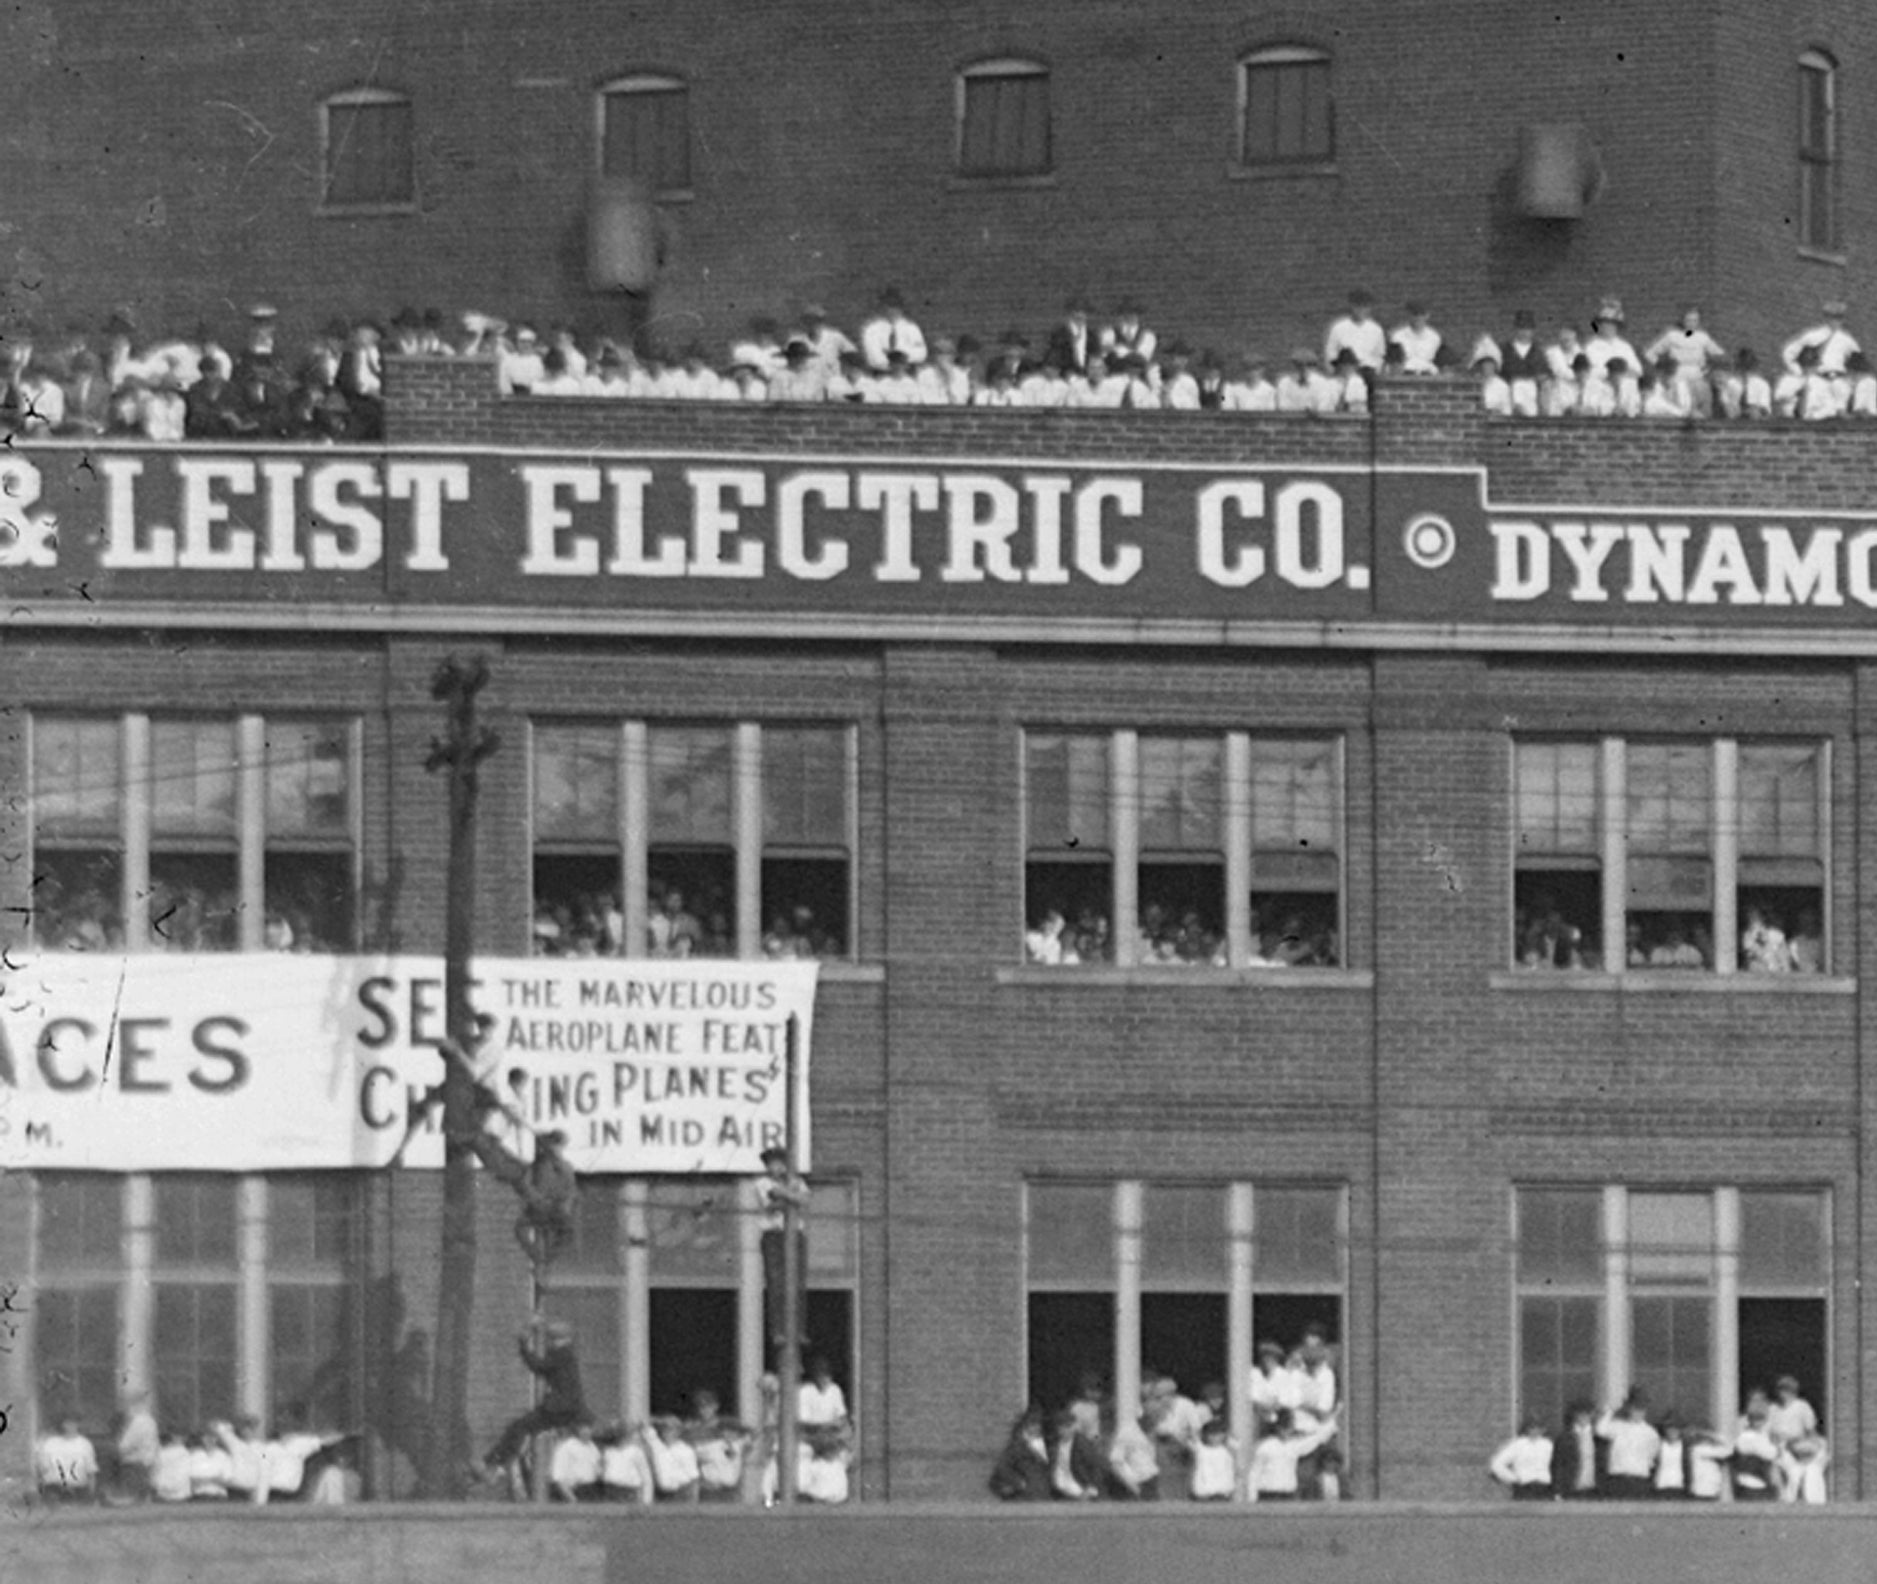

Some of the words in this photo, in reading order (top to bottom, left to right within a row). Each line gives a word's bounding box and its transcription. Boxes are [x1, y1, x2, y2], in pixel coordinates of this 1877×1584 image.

[99, 457, 471, 573] LEIST
[520, 466, 1147, 587] ELECTRIC
[1197, 480, 1372, 591] CO.
[501, 977, 562, 1011] THE
[579, 979, 778, 1011] MARVELOUS
[505, 1015, 684, 1055] AEROPLANE
[702, 1018, 780, 1057] FEAT
[589, 1120, 624, 1149] IN
[638, 1114, 707, 1148] MID
[716, 1113, 784, 1152] AIR
